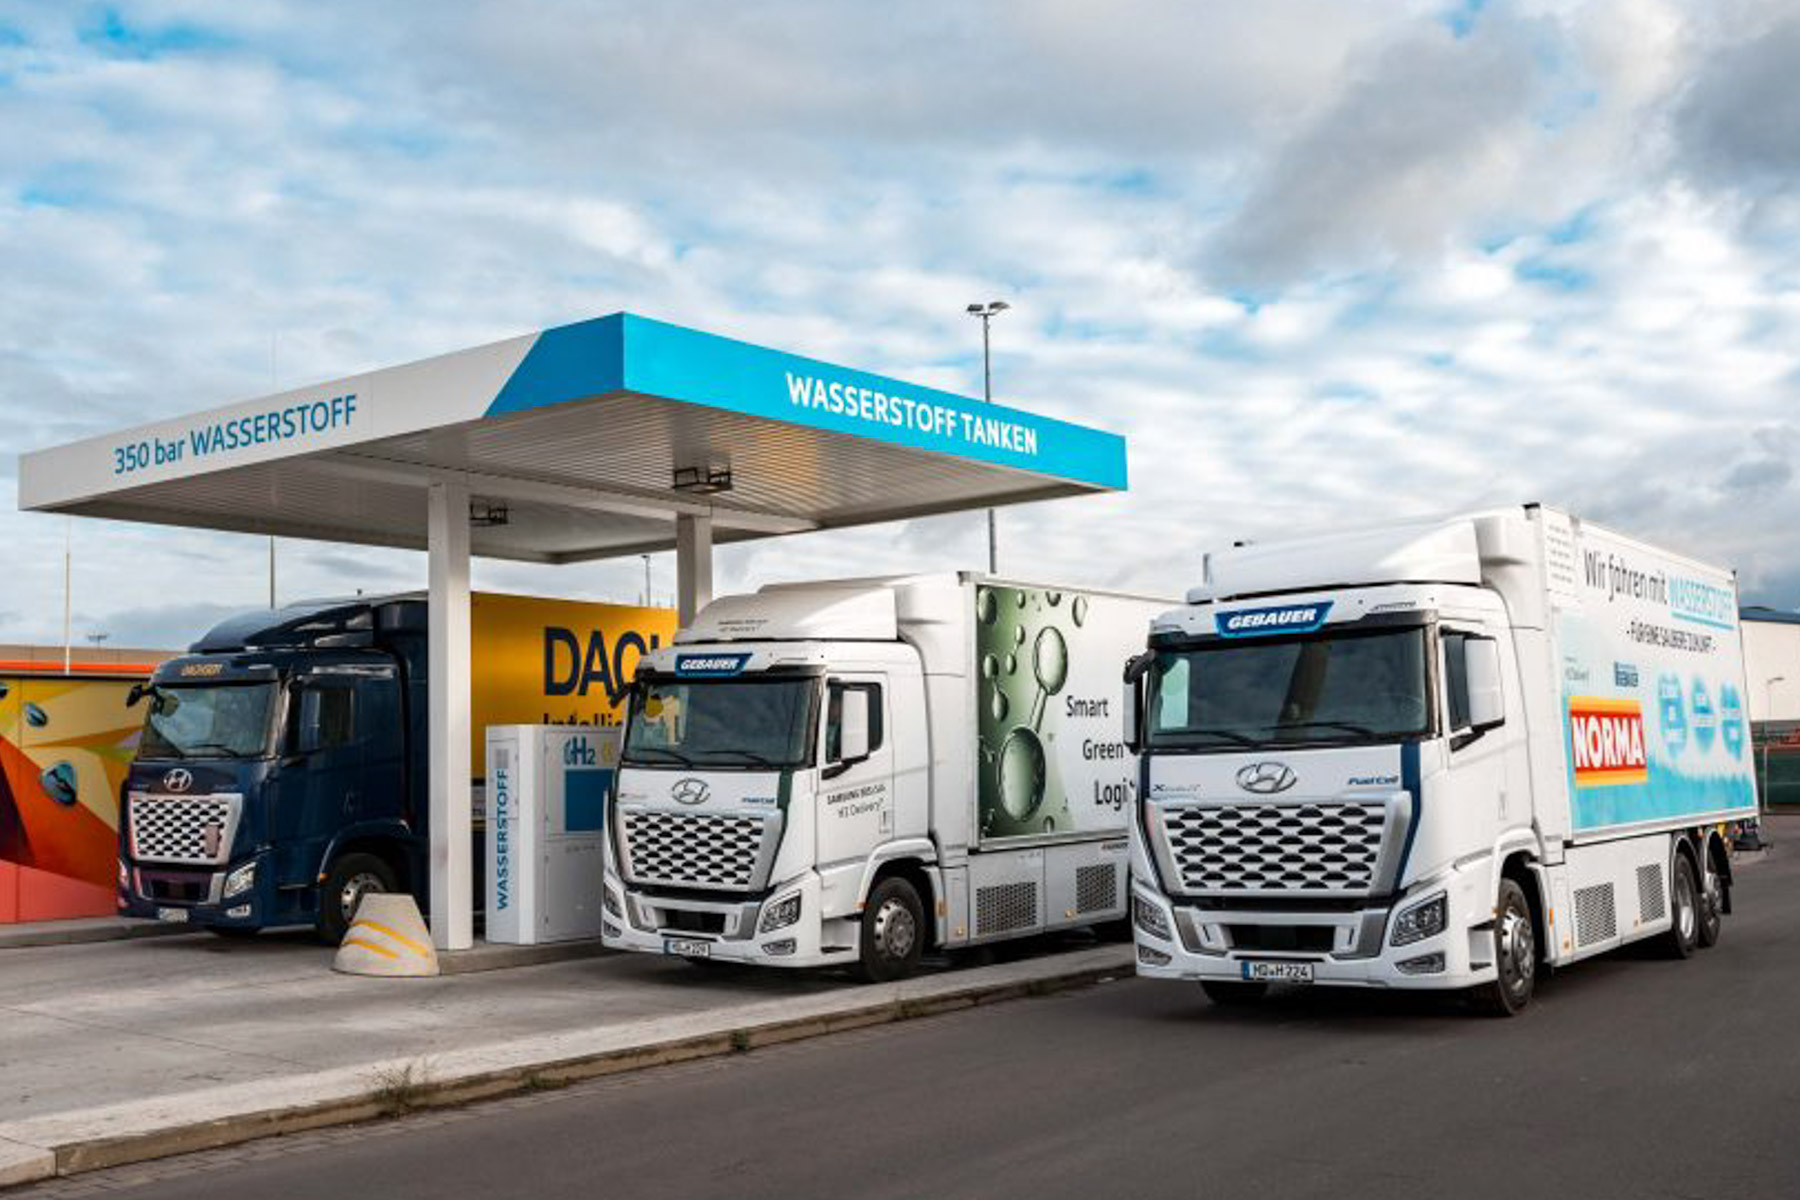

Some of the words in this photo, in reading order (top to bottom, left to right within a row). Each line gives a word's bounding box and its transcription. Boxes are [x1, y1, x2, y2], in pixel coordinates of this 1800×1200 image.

[114, 442, 149, 474] 350
[155, 438, 185, 466] bar
[190, 394, 357, 457] WASSERSTOFF
[785, 372, 957, 437] WASSERSTOFF
[960, 413, 1038, 456] TANKEN
[1584, 549, 1606, 590] Wir
[1608, 553, 1648, 603] fahren
[1649, 569, 1667, 605] mit
[1228, 608, 1318, 630] GEBAUER
[544, 626, 660, 697] DAC
[680, 658, 740, 670] GEBAUER
[1066, 695, 1109, 718] Smart
[1082, 739, 1125, 761] Green
[1572, 714, 1646, 769] NORMA
[1094, 777, 1135, 812] Logi
[496, 769, 509, 911] WASSERSTOFF
